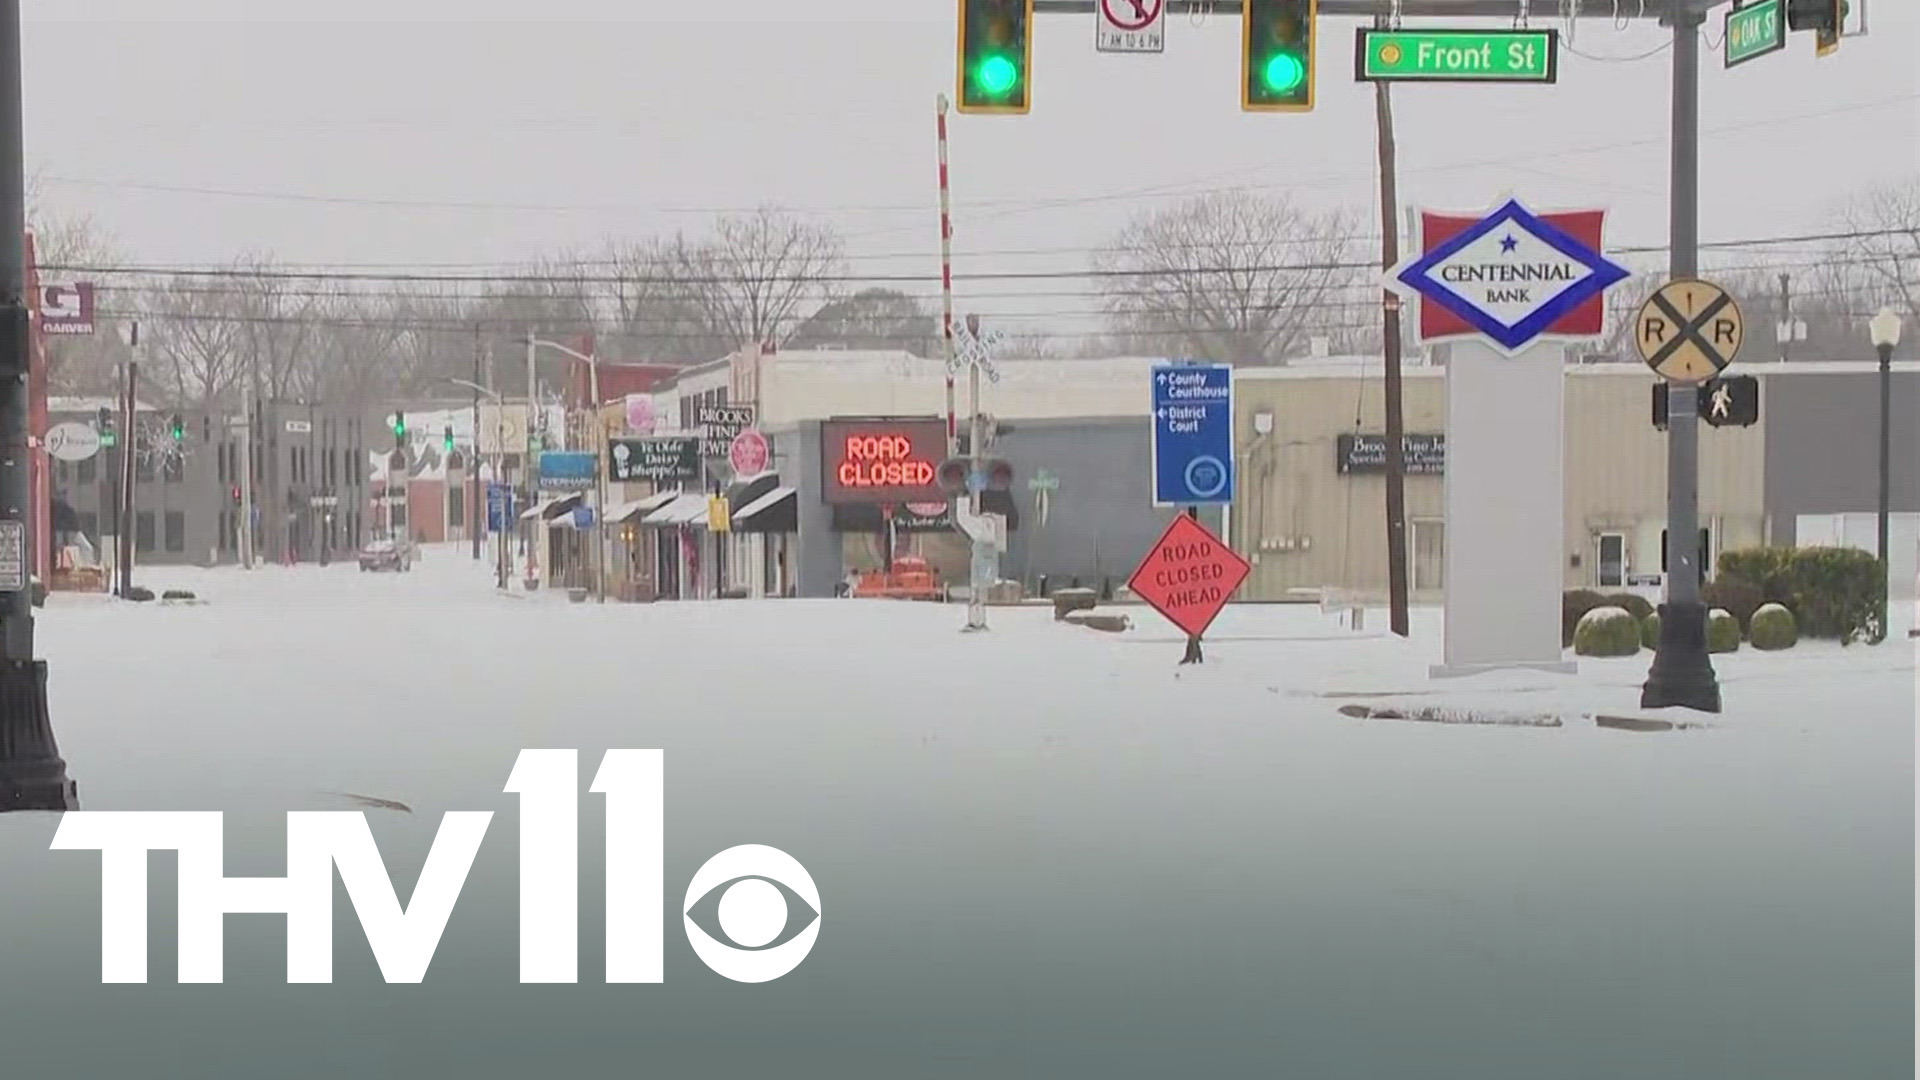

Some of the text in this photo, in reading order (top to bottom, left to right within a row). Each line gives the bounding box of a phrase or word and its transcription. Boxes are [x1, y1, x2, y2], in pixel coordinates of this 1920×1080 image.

[1110, 33, 1121, 47] AM
[1126, 33, 1135, 47] TO
[1149, 33, 1159, 47] PM
[1418, 41, 1535, 69] Front St
[1442, 263, 1575, 282] CENTENNIAL
[1487, 289, 1530, 303] BANK
[43, 323, 93, 333] GARVER
[1645, 318, 1735, 344] R R
[1168, 372, 1207, 387] County
[1168, 387, 1228, 399] Courthouse
[700, 409, 752, 423] BROOKS
[1168, 407, 1206, 419] District
[1168, 421, 1198, 433] Court
[656, 440, 684, 453] Olde
[847, 436, 910, 460] ROAD
[1353, 437, 1386, 452] Broo
[646, 453, 680, 466] Daisy
[839, 462, 933, 485] CLOSED
[1162, 542, 1211, 562] ROAD
[1156, 564, 1223, 587] CLOSED
[1166, 588, 1221, 608] AHEAD
